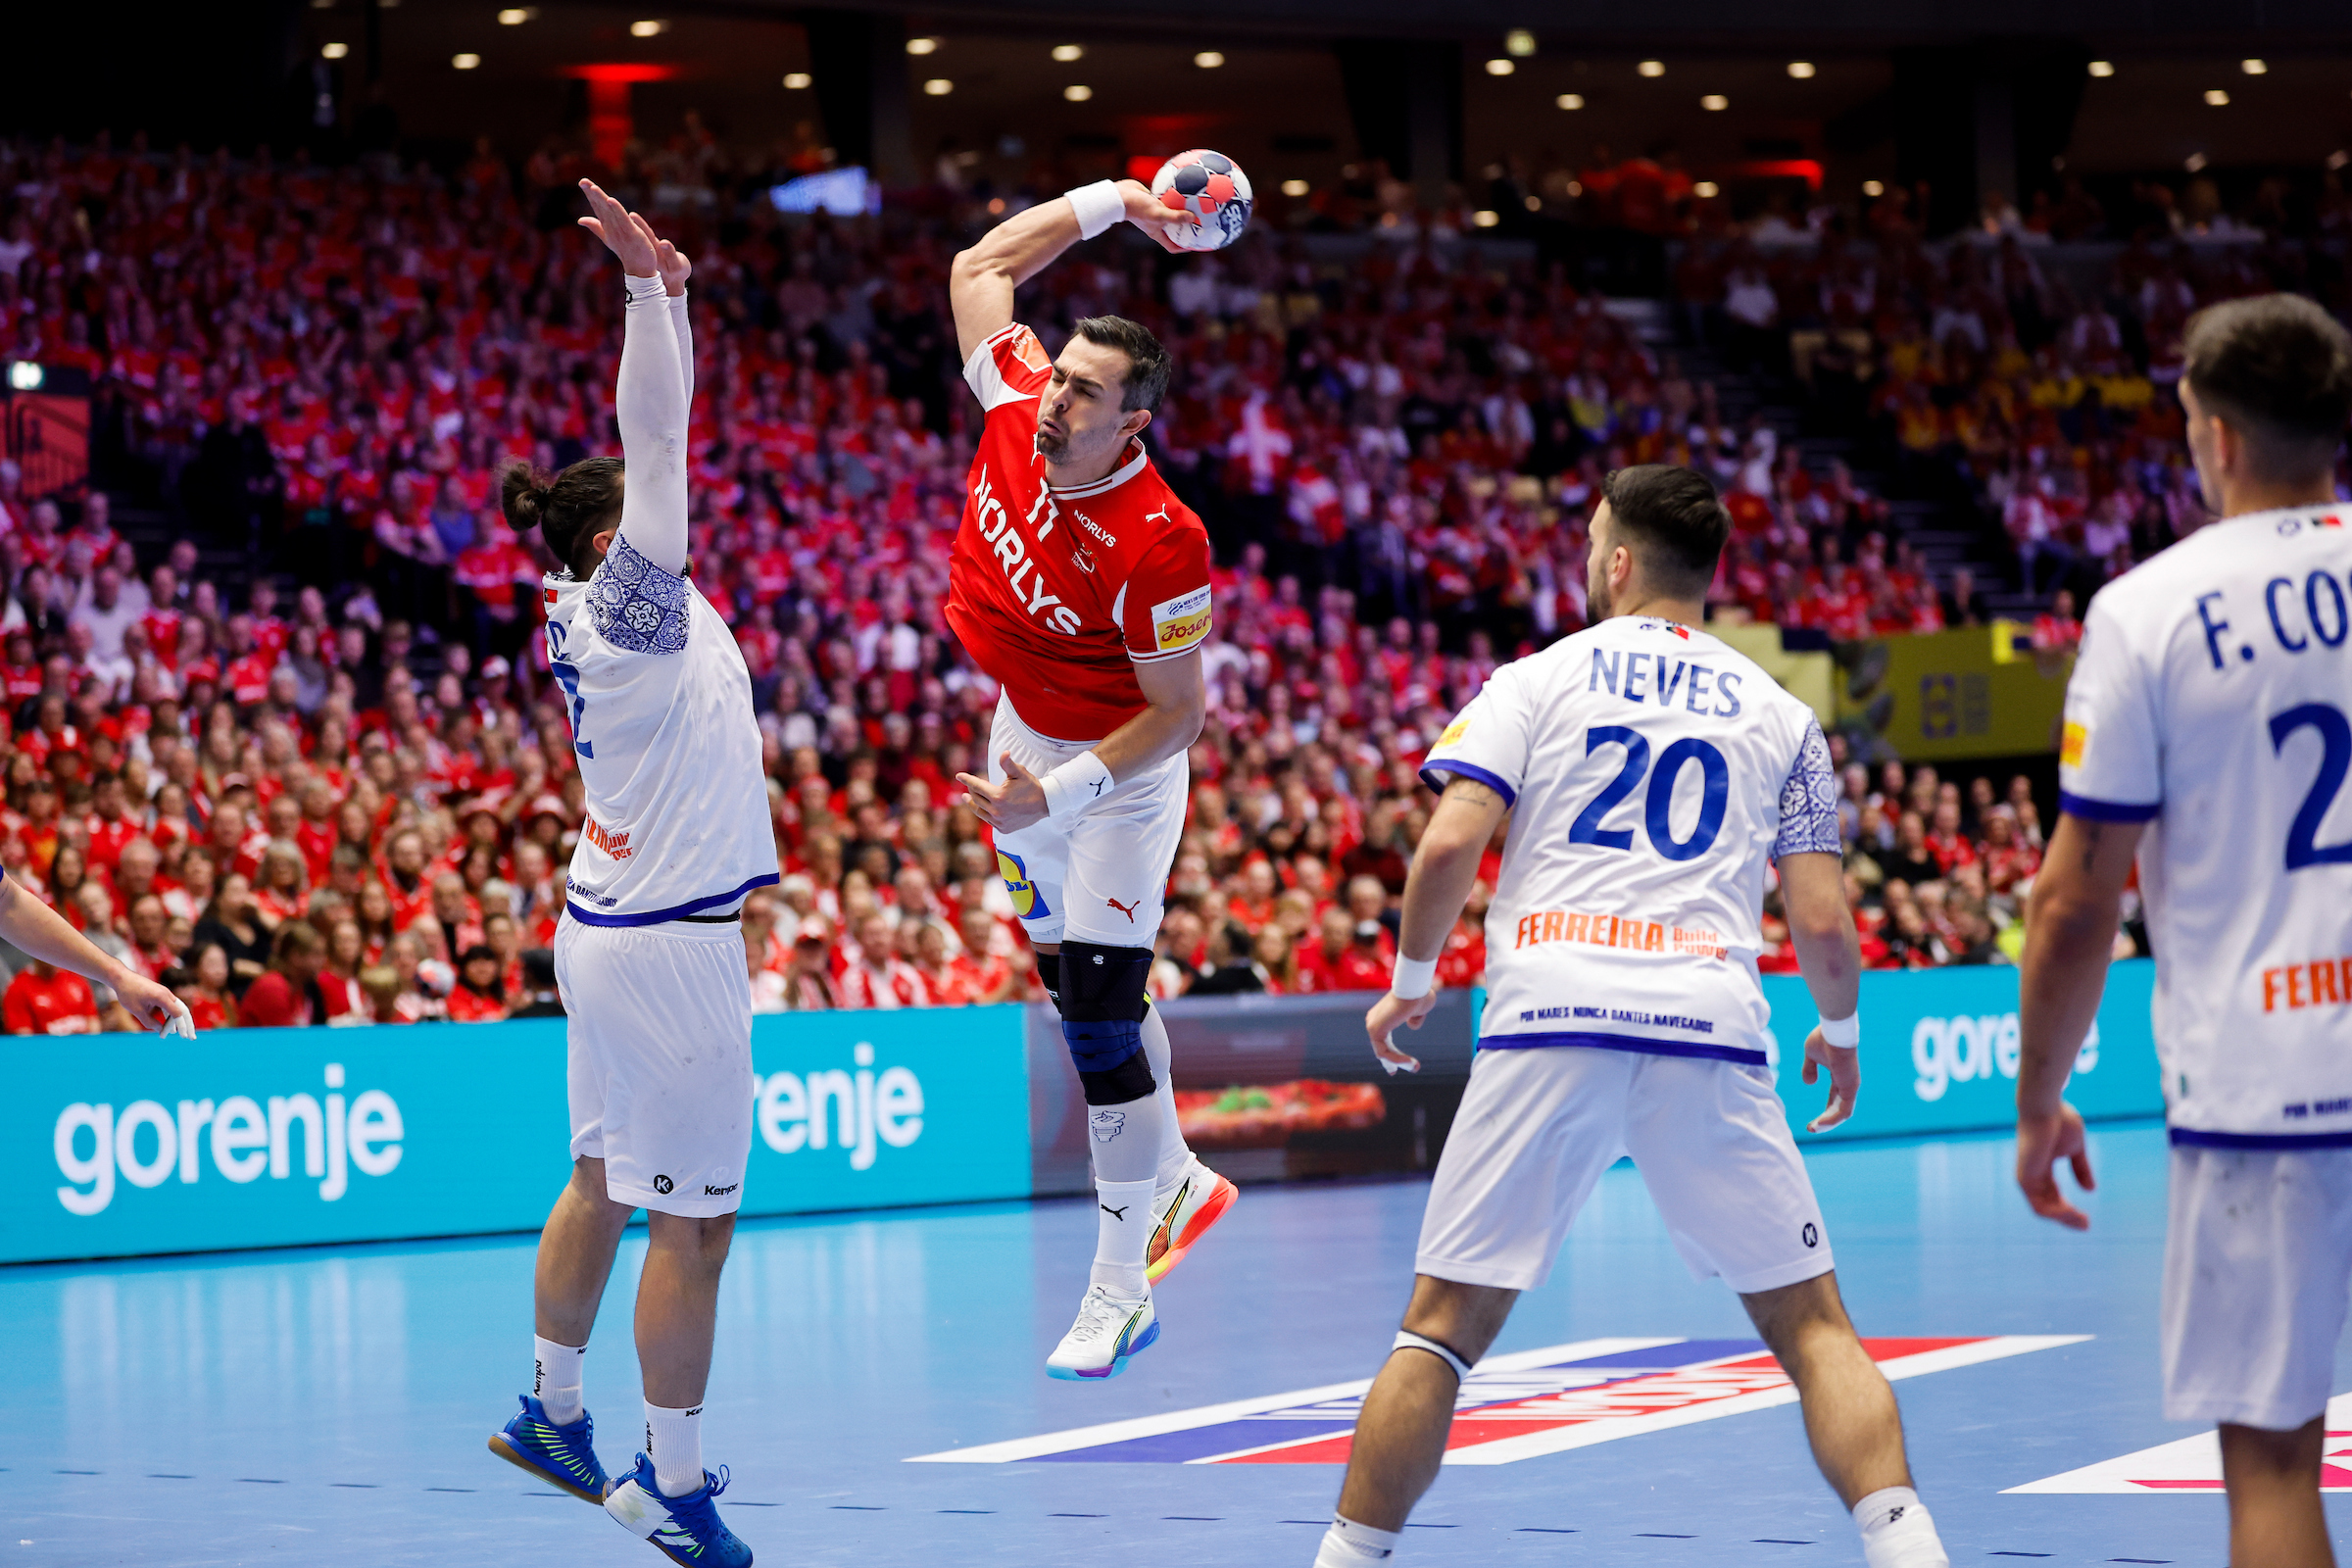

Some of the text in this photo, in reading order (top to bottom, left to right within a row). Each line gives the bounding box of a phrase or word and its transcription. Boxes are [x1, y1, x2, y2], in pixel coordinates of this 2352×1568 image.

[974, 463, 1081, 636] NORLYS
[1026, 476, 1059, 542] 11
[1074, 510, 1116, 547] NORLYS
[1160, 612, 1212, 642] Joser
[2196, 569, 2352, 669] F. CO
[1589, 648, 1742, 717] NEVES
[1569, 725, 1729, 861] 20
[1515, 911, 1664, 952] FERREIRA
[1911, 1011, 2100, 1102] goree
[54, 1062, 404, 1216] gorenje
[754, 1041, 924, 1171] enje
